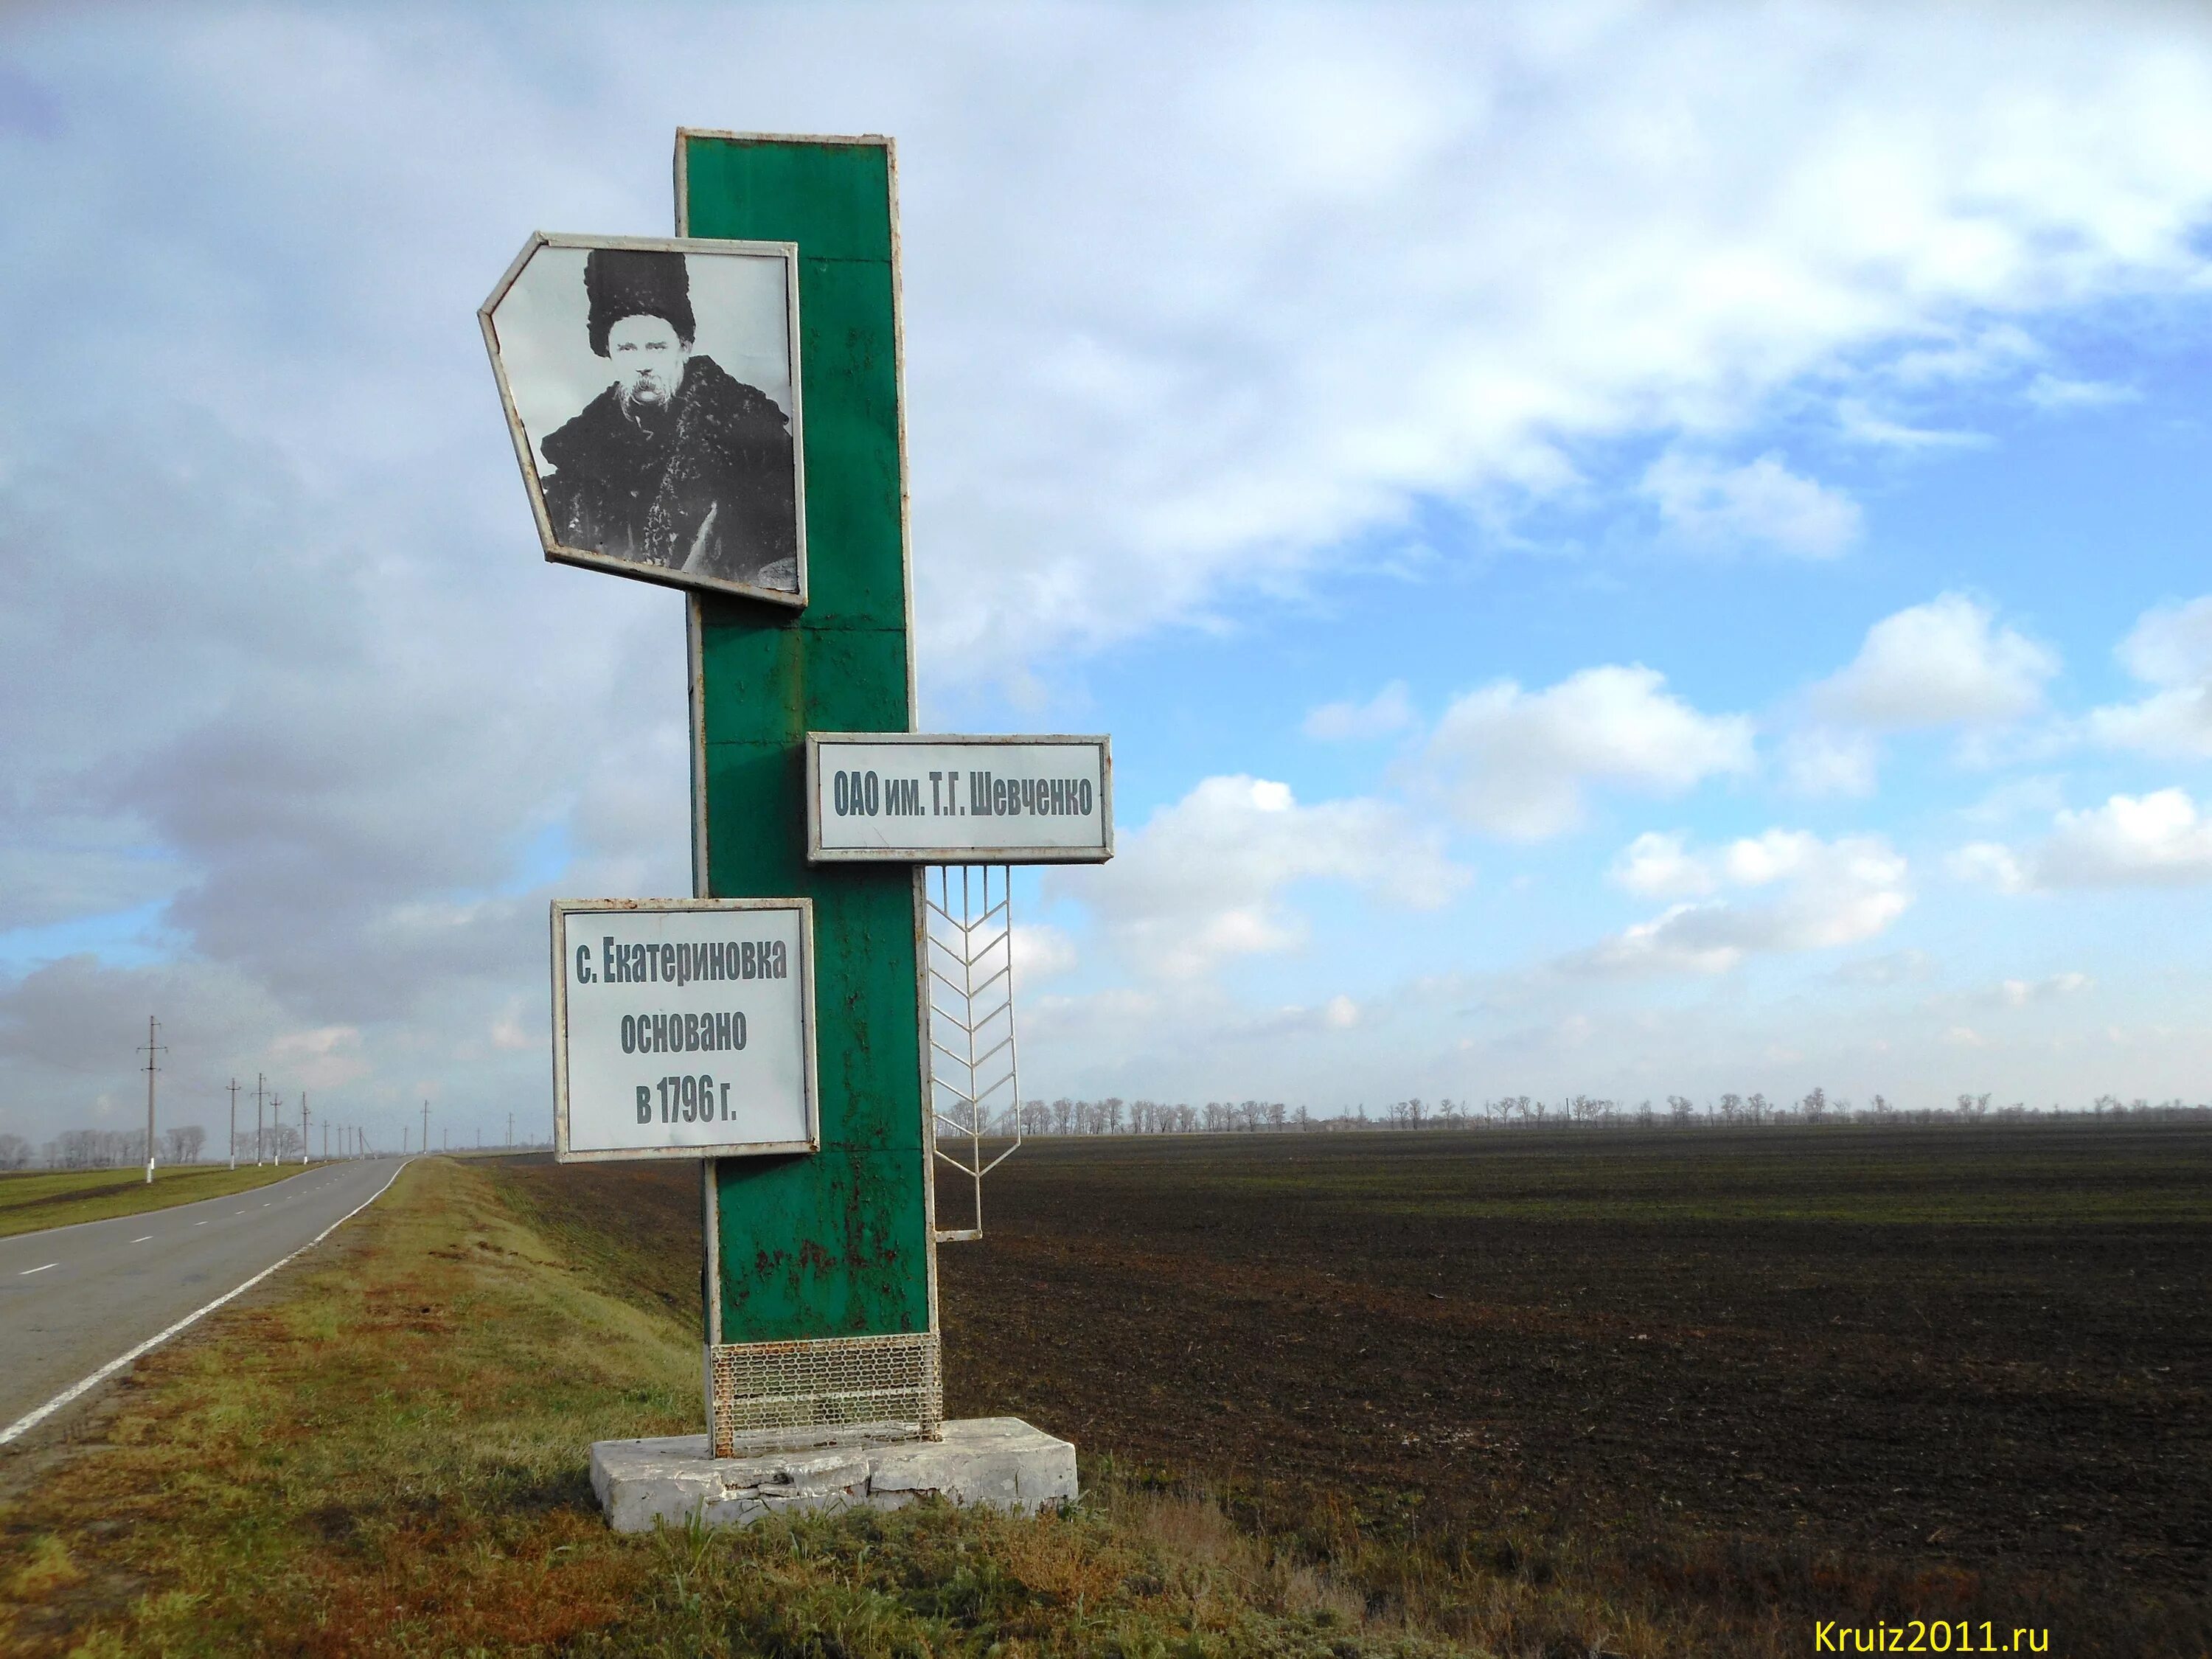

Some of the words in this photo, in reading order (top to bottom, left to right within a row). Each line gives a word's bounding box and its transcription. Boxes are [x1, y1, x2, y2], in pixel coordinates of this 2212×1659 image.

[834, 770, 880, 816] ОАО
[885, 779, 925, 816] им.
[970, 771, 1093, 816] Шевченко
[602, 936, 787, 987] Екатериновка
[621, 1011, 747, 1054] основано
[636, 1085, 652, 1124] в
[656, 1074, 714, 1123] 1796
[720, 1082, 737, 1121] г.
